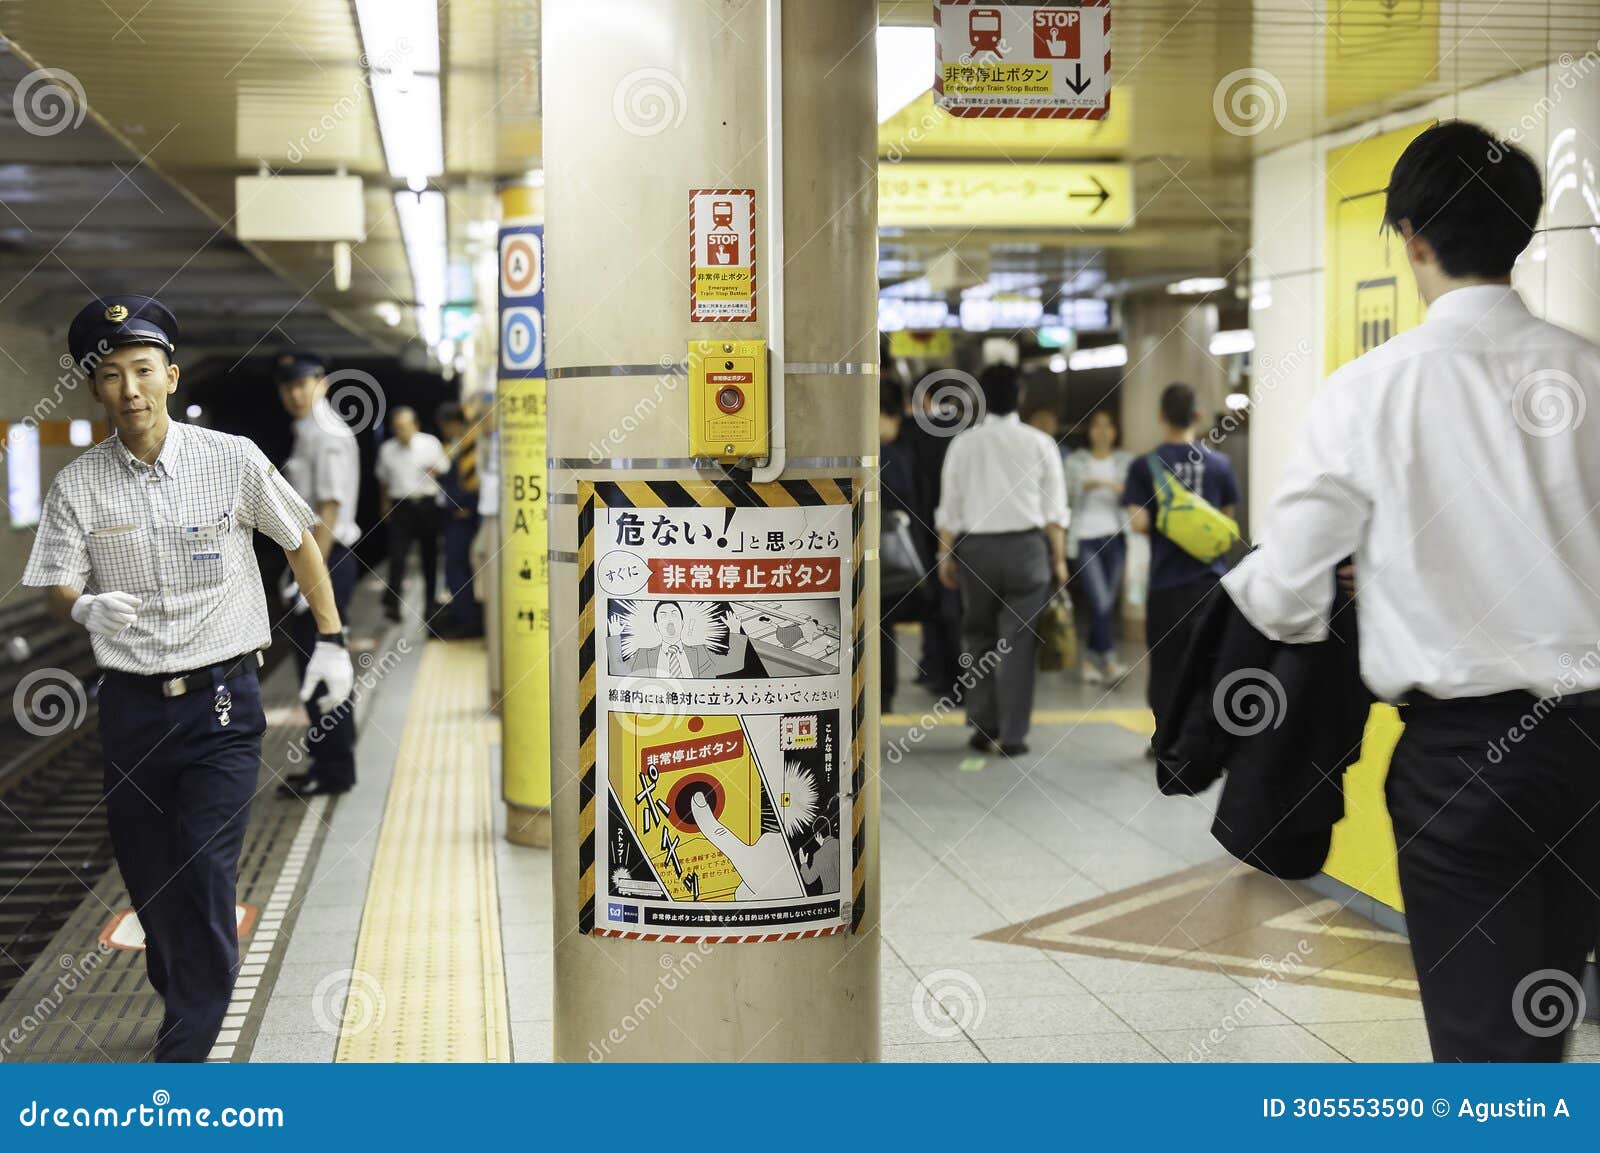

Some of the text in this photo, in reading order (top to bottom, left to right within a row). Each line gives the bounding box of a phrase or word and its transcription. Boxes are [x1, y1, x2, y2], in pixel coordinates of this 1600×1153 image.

[1034, 12, 1080, 28] STOP
[945, 67, 1049, 83] 非常停止ボタン
[946, 85, 984, 93] Emergency
[1006, 85, 1023, 93] Stop
[708, 234, 738, 245] STOP
[513, 256, 523, 273] A
[698, 273, 749, 281] 非常停止ボタン
[513, 475, 541, 501] B5
[605, 565, 640, 582] すぐに
[662, 564, 832, 588] 非常停止ボタン
[646, 741, 738, 766] 非常停止ボタン
